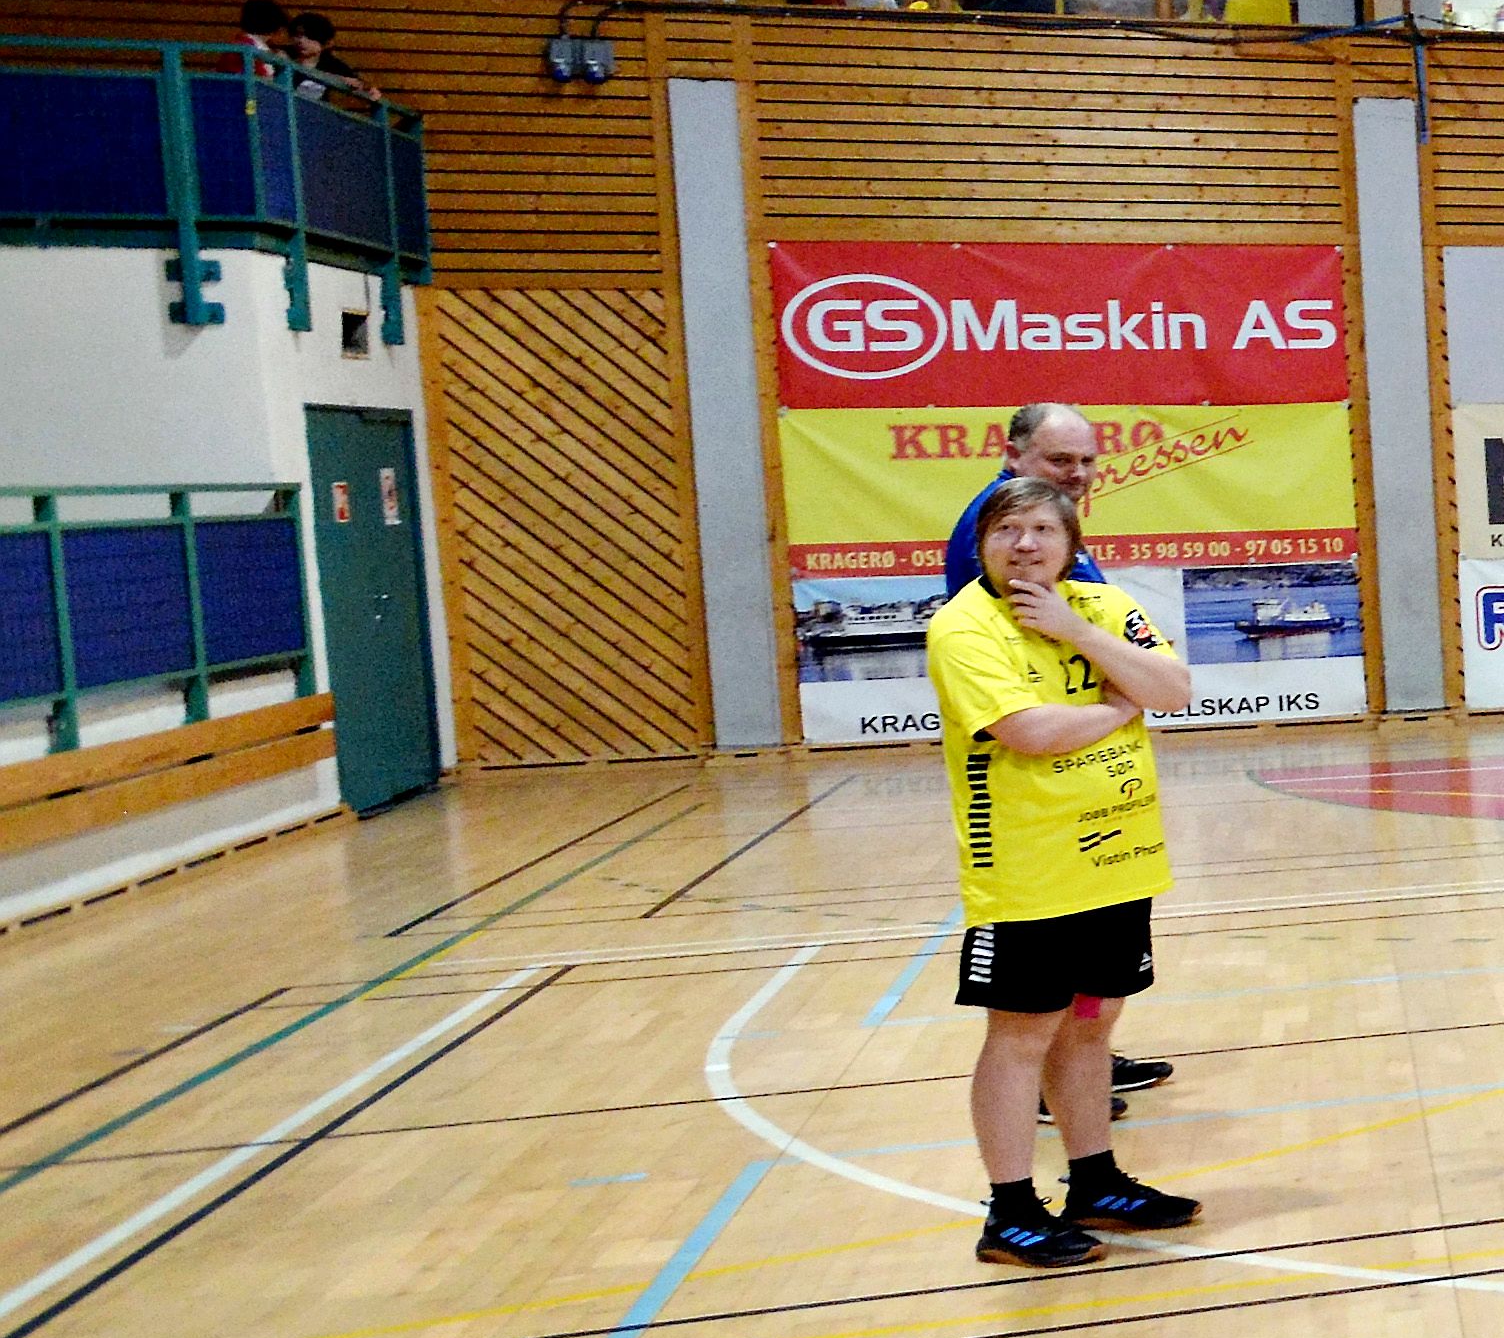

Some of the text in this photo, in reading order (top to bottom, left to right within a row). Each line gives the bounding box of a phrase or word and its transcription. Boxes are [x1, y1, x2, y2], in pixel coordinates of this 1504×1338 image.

[806, 298, 1338, 352] GS Maskin AS
[889, 419, 1164, 460] KRARØ
[1082, 426, 1249, 518] pressen
[805, 549, 896, 570] KRAGERØ
[911, 548, 946, 567] OSL
[1130, 542, 1150, 560] 35
[1157, 541, 1178, 559] 98
[1183, 541, 1204, 558] 59
[1208, 540, 1230, 557] 00
[1246, 539, 1267, 556] 97
[1270, 538, 1292, 555] 05
[1297, 537, 1318, 553] 15
[1322, 536, 1344, 552] 10
[861, 712, 940, 736] KRAG
[1277, 691, 1321, 712] IKS
